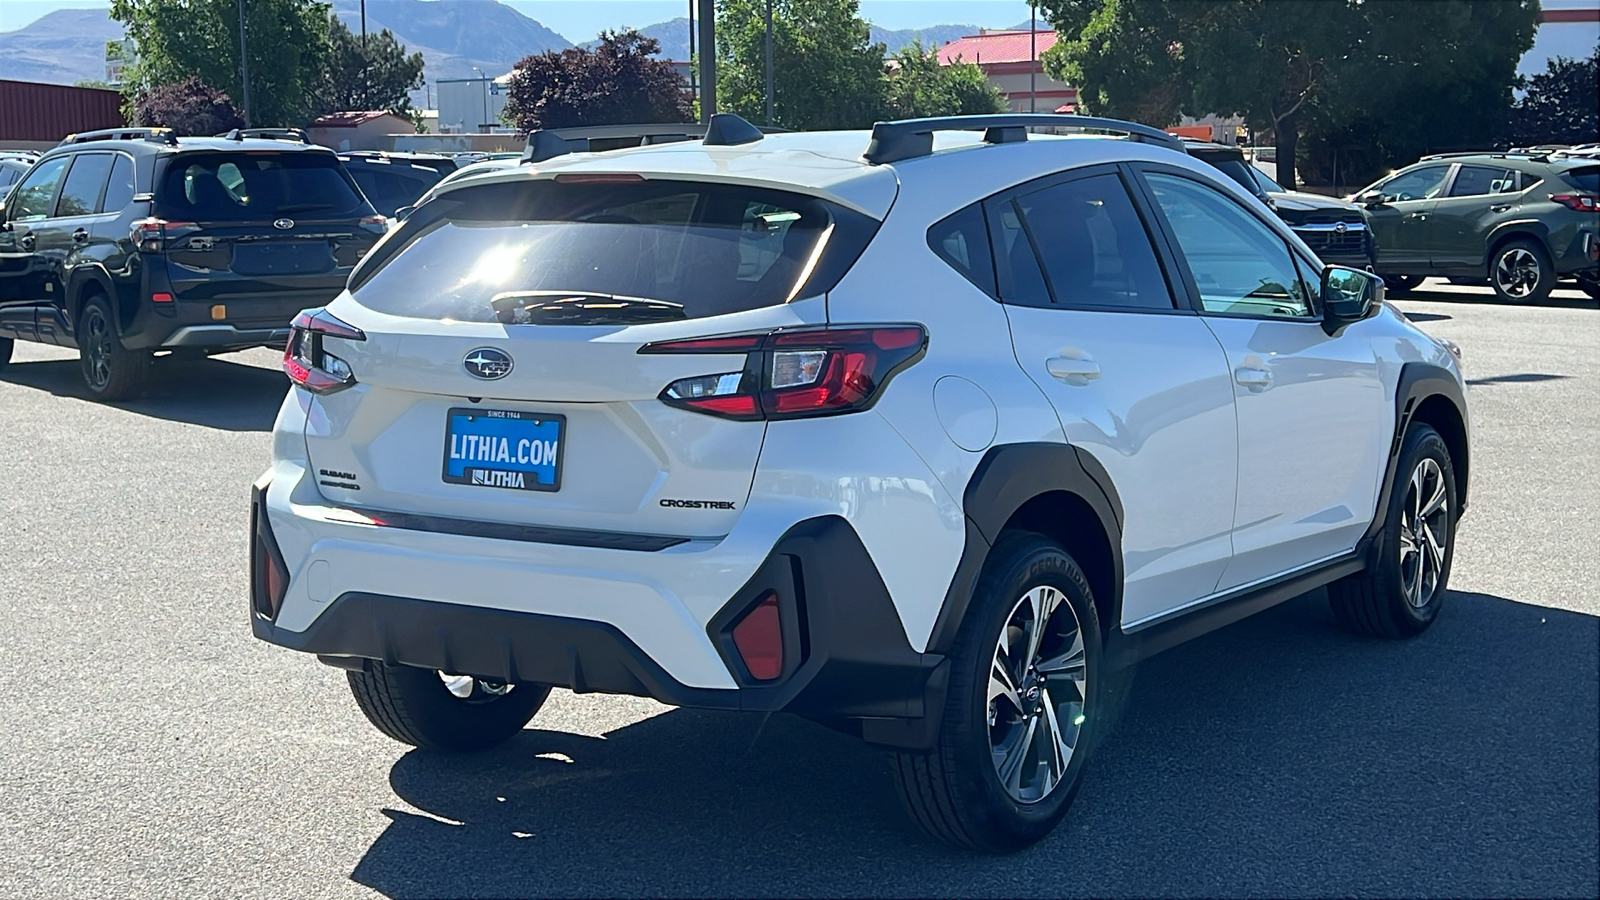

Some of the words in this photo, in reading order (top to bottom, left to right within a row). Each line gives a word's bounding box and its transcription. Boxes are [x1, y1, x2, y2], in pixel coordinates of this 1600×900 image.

[487, 410, 505, 419] SINCE
[450, 434, 558, 467] LITHIA.COM
[319, 469, 356, 480] SUBARU
[484, 470, 525, 488] LITHIA
[659, 499, 736, 510] CROSSTREK
